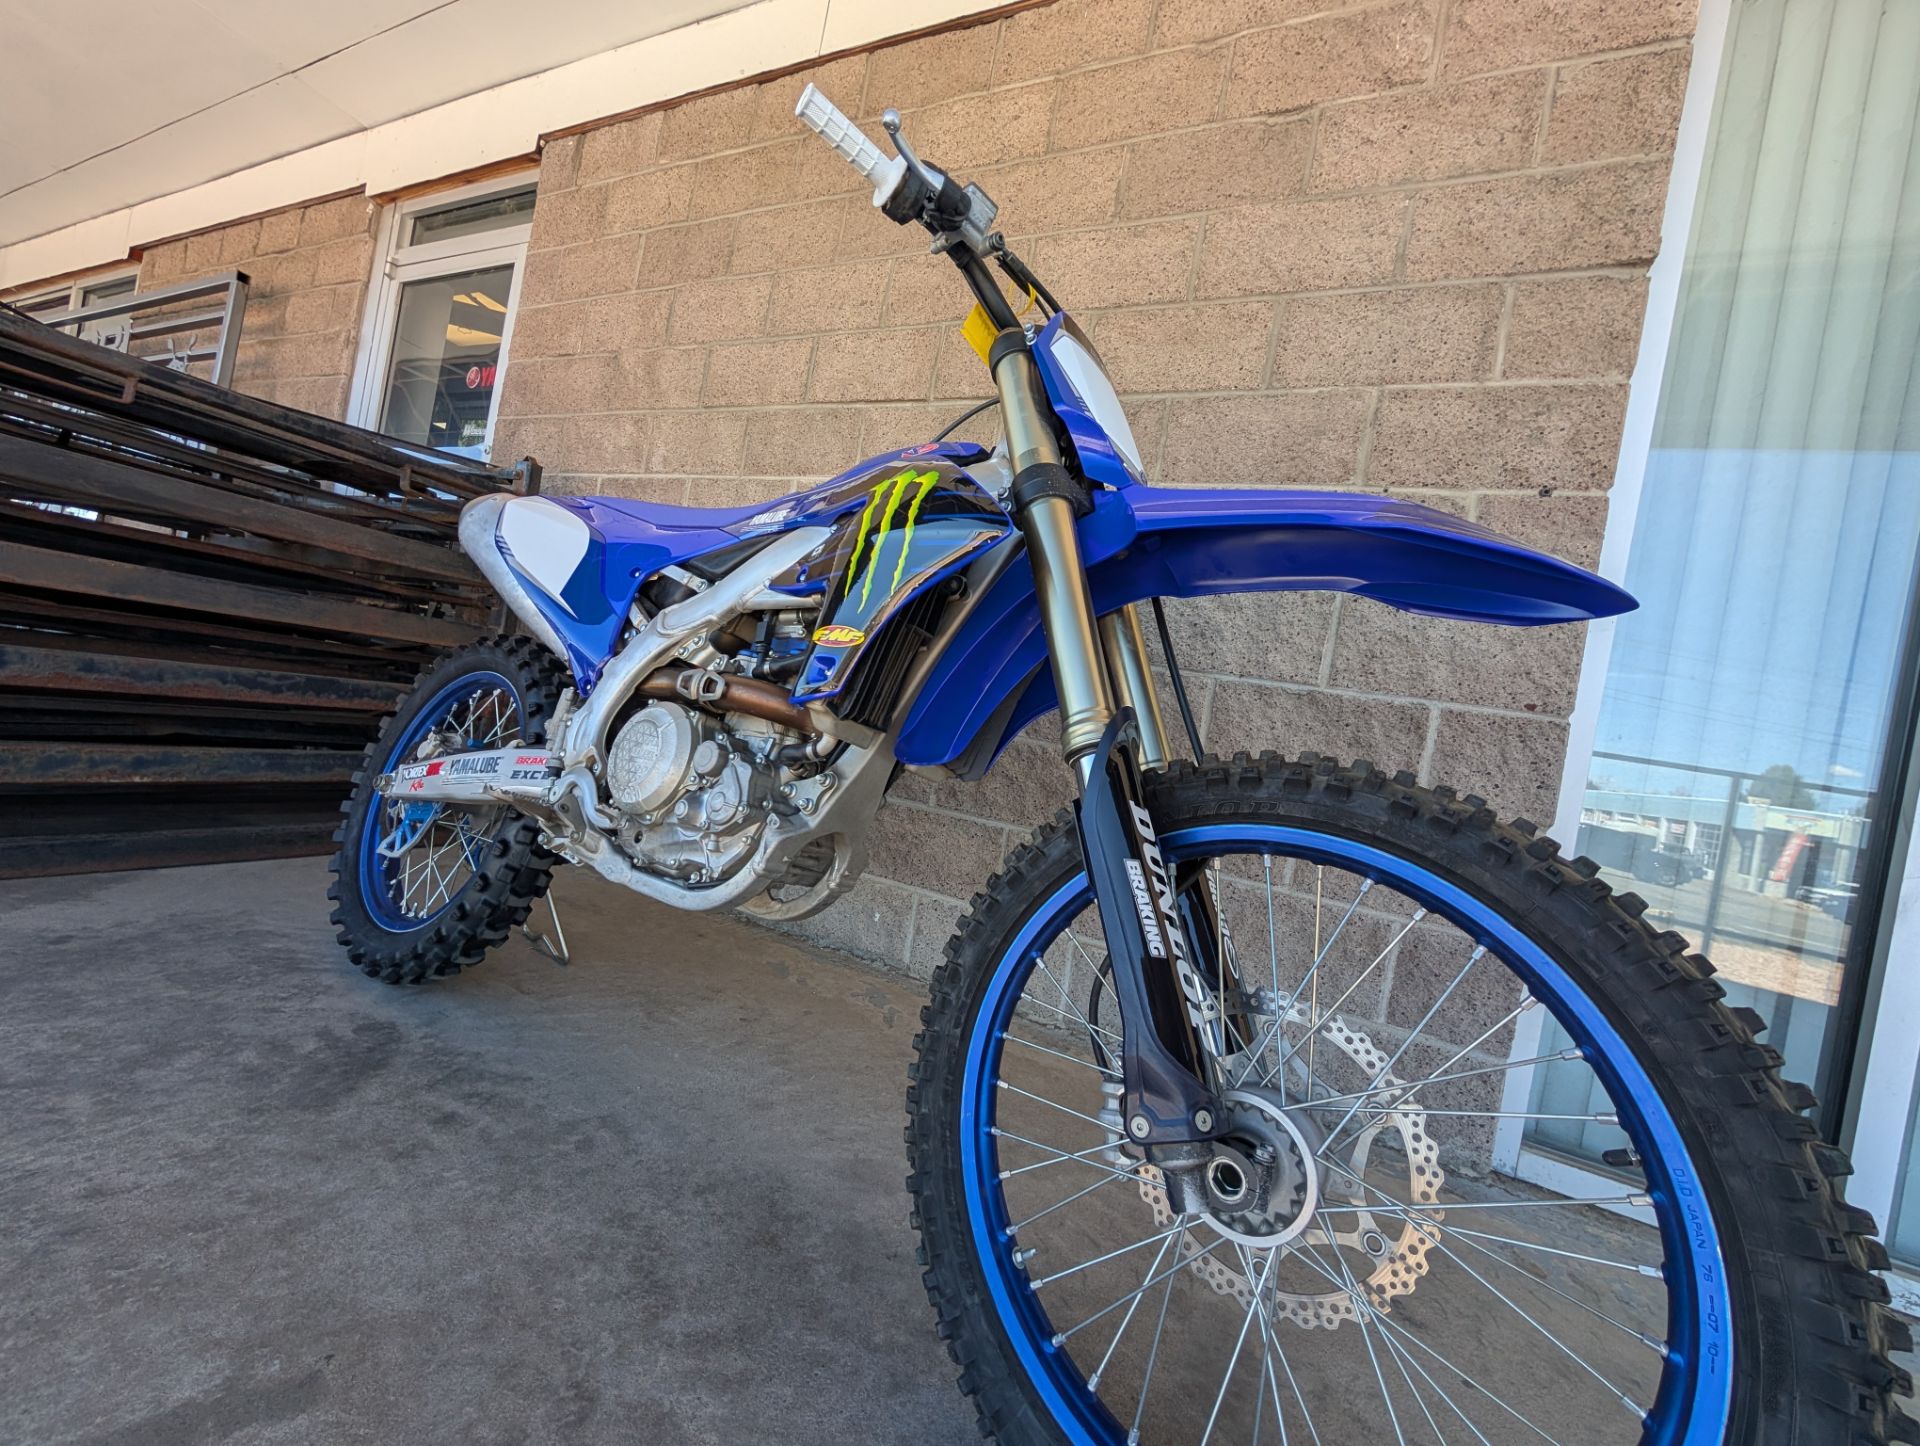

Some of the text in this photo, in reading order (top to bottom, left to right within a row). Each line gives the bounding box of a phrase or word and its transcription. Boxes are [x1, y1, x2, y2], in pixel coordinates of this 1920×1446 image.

[449, 757, 501, 776] YAMALUBE
[1126, 861, 1164, 957] BRAKING
[1129, 799, 1213, 1053] DUNLOP
[1686, 1204, 1708, 1249] JAPAN
